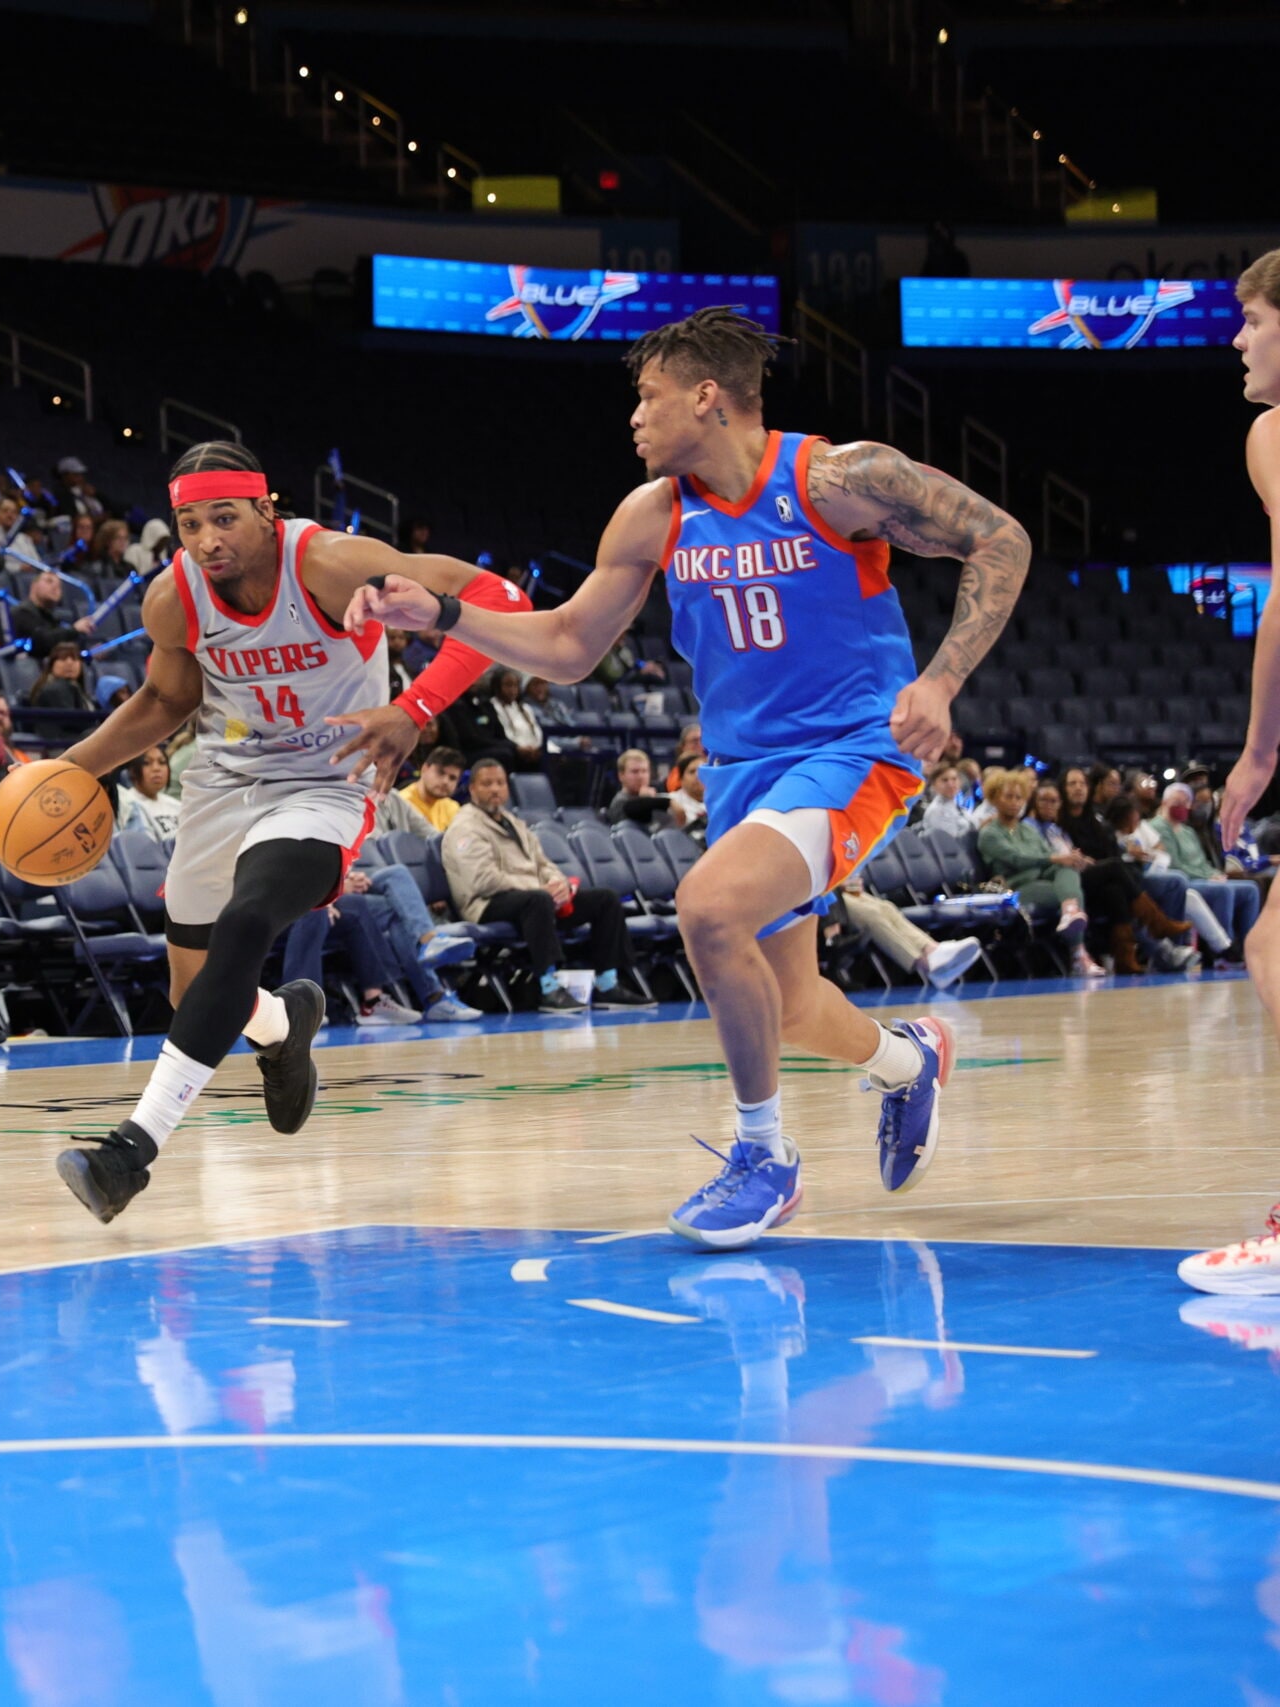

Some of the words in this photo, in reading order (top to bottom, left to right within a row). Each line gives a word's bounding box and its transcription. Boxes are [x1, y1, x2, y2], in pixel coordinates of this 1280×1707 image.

[103, 191, 220, 268] OKC
[520, 282, 601, 307] BLUE
[1070, 294, 1158, 317] BLUE
[672, 545, 732, 583] OKC
[735, 535, 818, 581] BLUE
[710, 582, 787, 652] 18
[206, 641, 328, 677] VIPERS
[247, 684, 306, 728] 14
